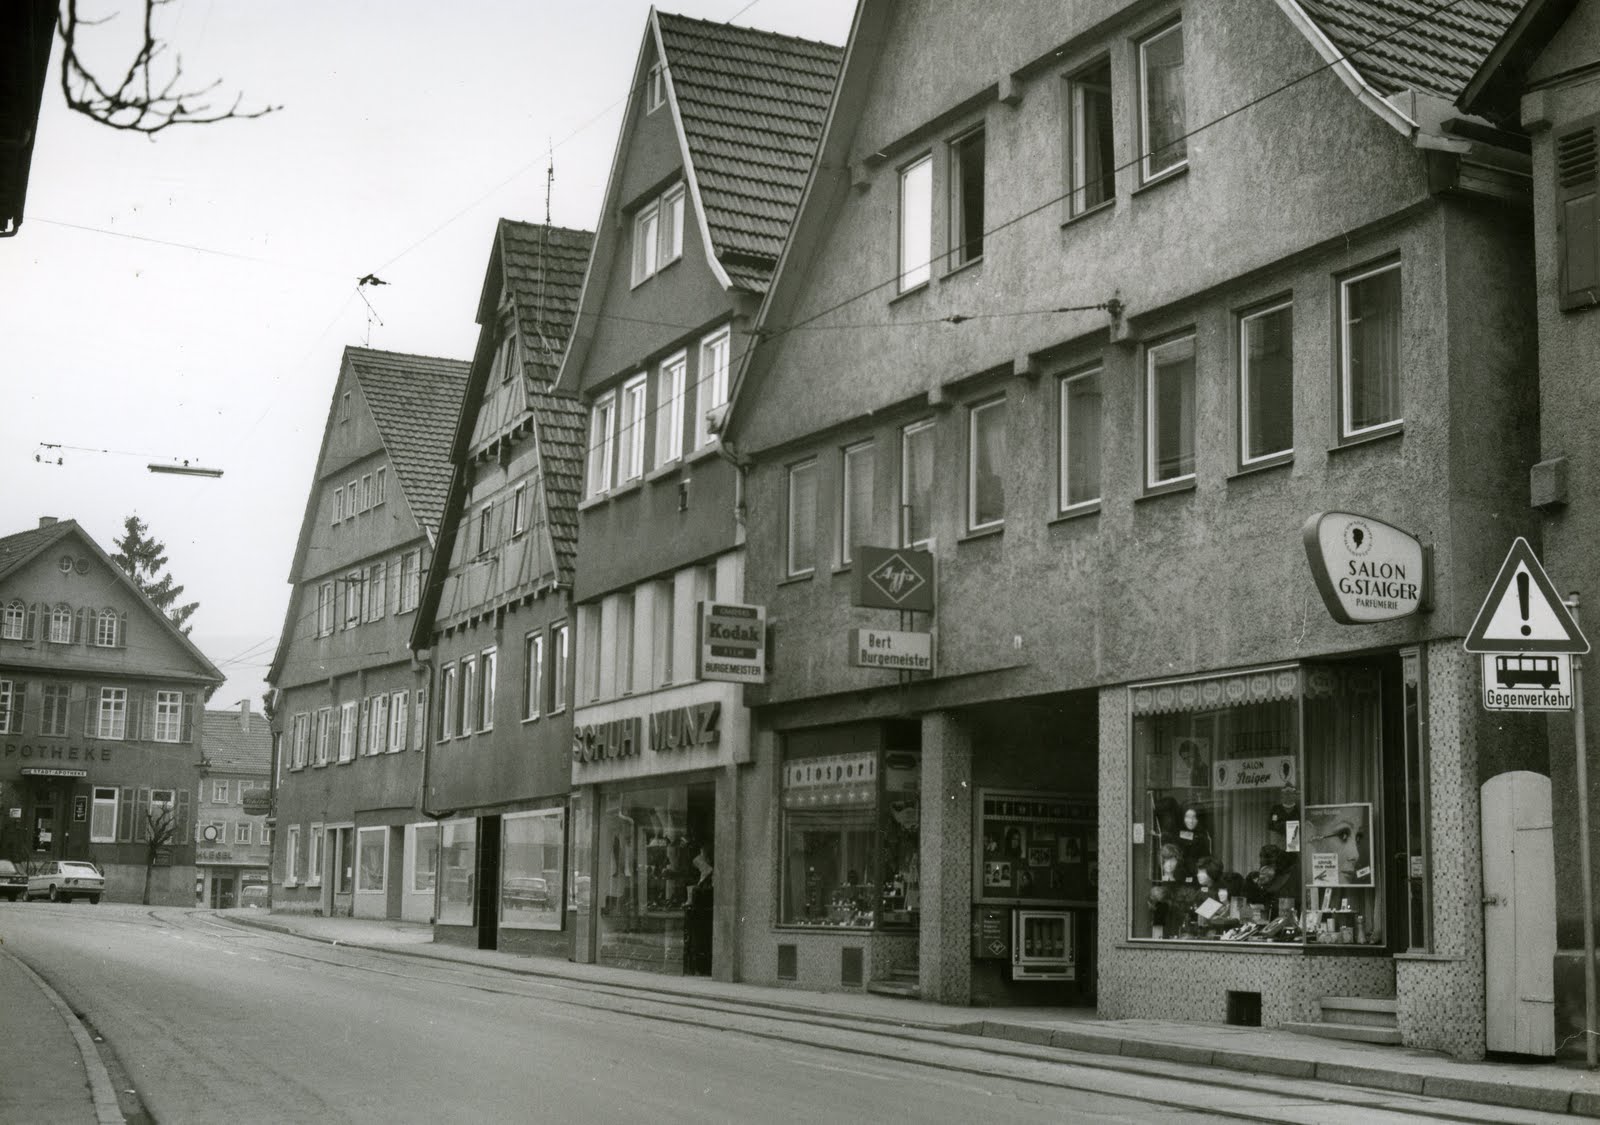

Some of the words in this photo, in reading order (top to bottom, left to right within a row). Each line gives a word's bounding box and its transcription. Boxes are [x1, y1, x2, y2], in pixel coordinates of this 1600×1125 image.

[875, 566, 915, 593] Agfa
[1348, 559, 1406, 581] SALON
[1339, 577, 1417, 599] G.STAIGER
[709, 622, 761, 641] Kodak
[869, 633, 891, 649] Bert
[861, 649, 929, 667] Burgemeister
[705, 662, 761, 675] BURGEMEISTER
[1487, 689, 1570, 708] Gegenverkehr
[573, 716, 642, 764] SCHUH
[787, 759, 874, 786] fotosport
[1241, 761, 1264, 770] SALON
